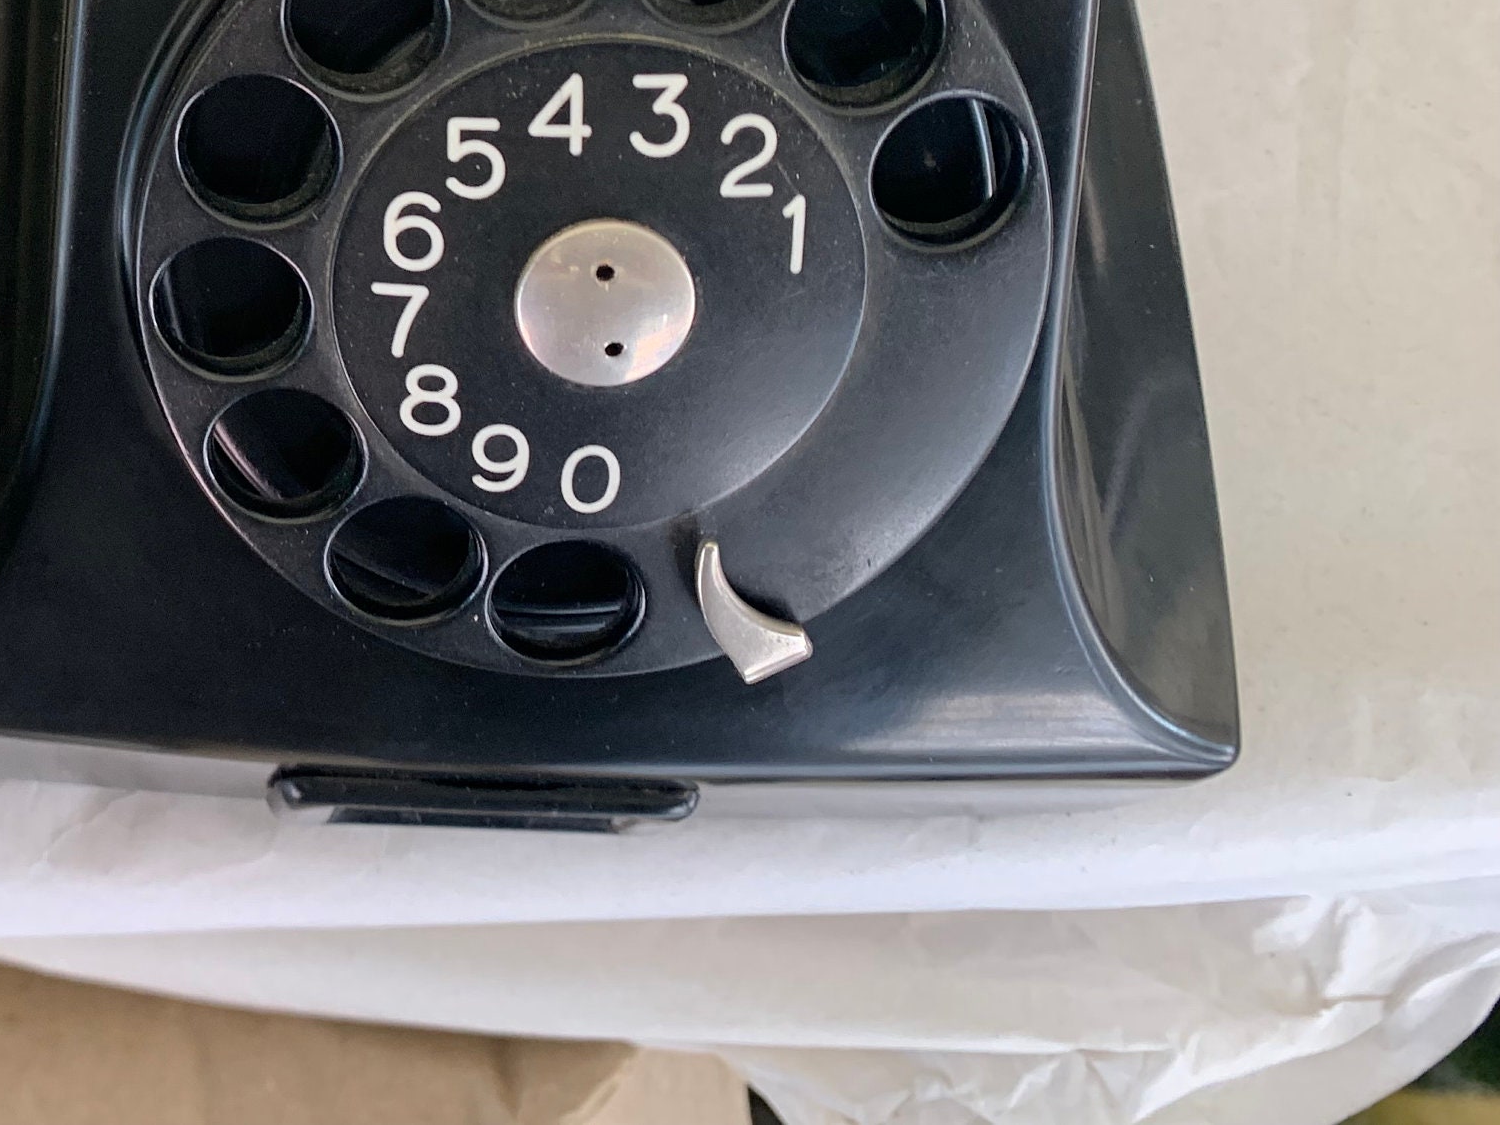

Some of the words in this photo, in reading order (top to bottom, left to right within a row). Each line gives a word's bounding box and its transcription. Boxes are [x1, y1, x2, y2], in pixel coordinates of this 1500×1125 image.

[528, 73, 593, 156] 4
[630, 73, 690, 158] 3
[445, 116, 506, 200] 5
[720, 113, 778, 198] 2
[383, 191, 445, 272] 6
[782, 193, 807, 275] 1
[371, 282, 430, 358] 7
[399, 363, 462, 437] 8
[471, 423, 530, 493] 9
[560, 444, 621, 514] 0
